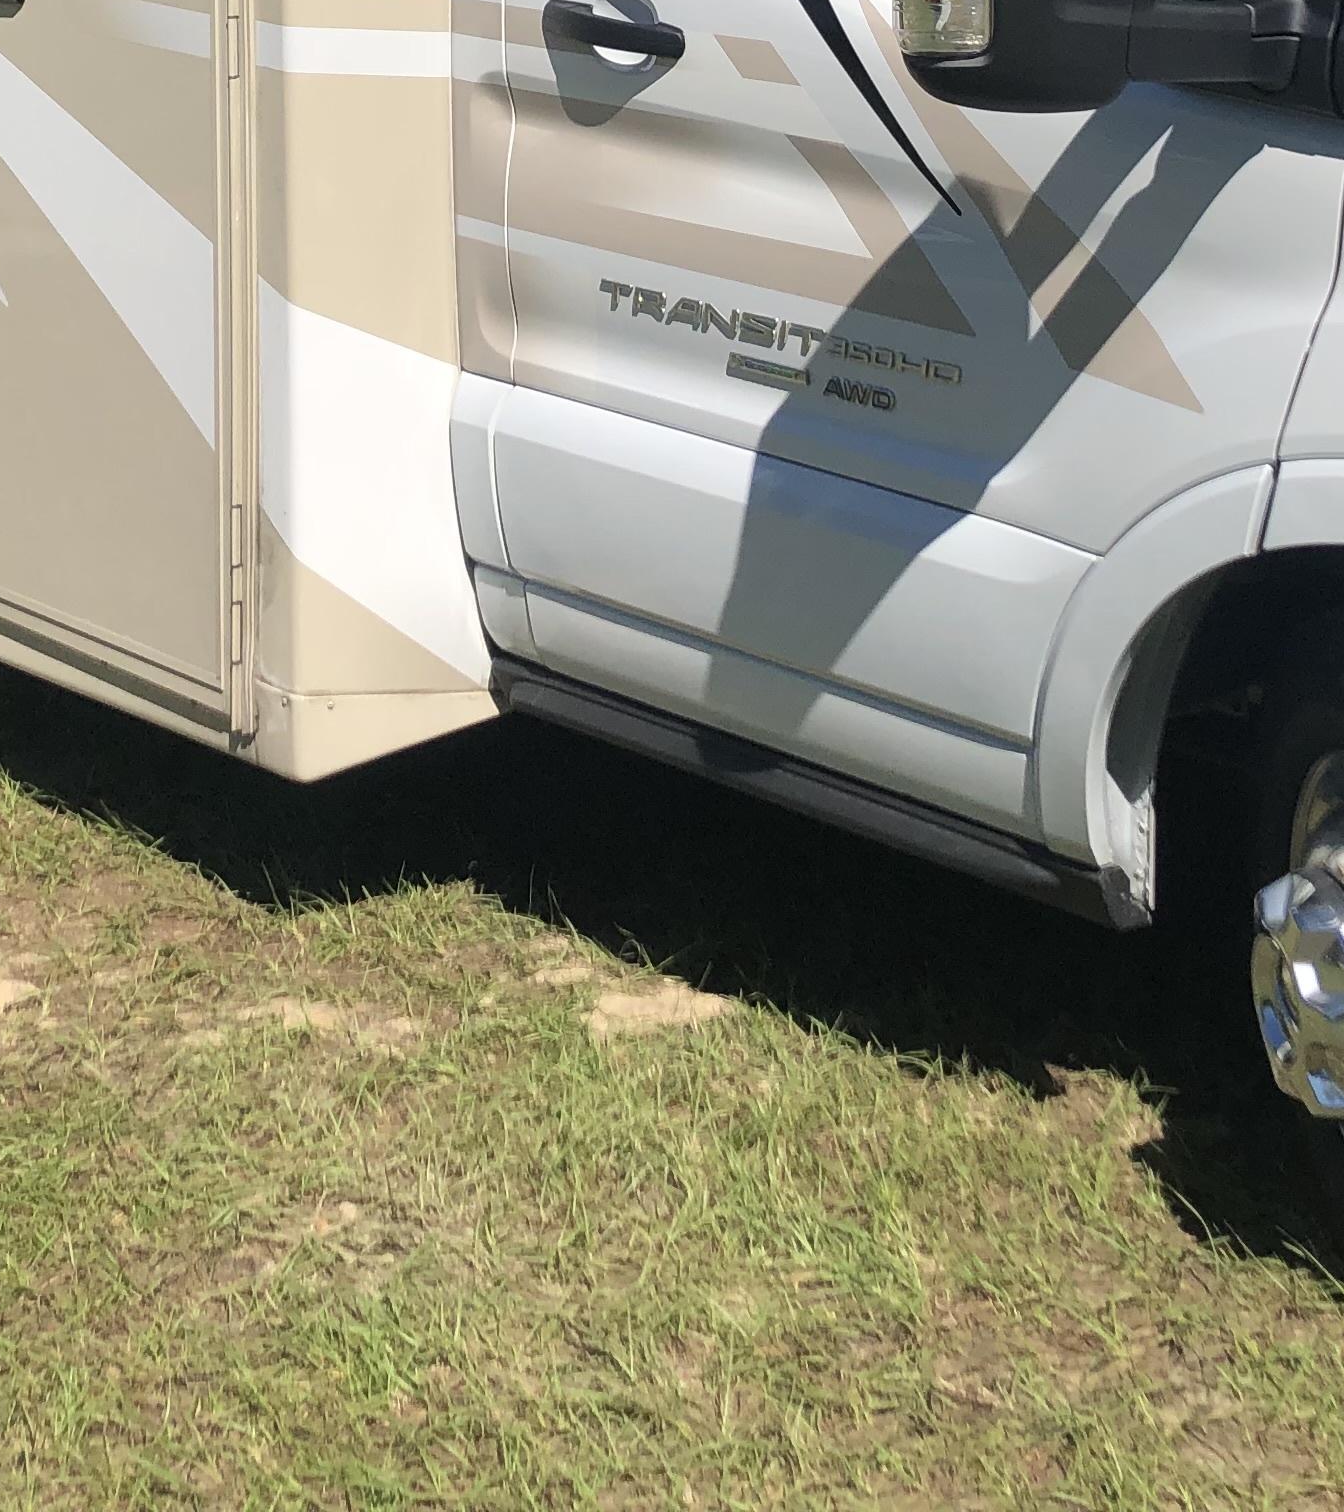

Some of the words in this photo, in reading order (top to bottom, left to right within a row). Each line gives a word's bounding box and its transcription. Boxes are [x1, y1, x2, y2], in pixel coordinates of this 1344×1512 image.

[599, 278, 826, 356] TRANSIT
[826, 335, 962, 384] 350HD
[823, 375, 896, 410] AWD
